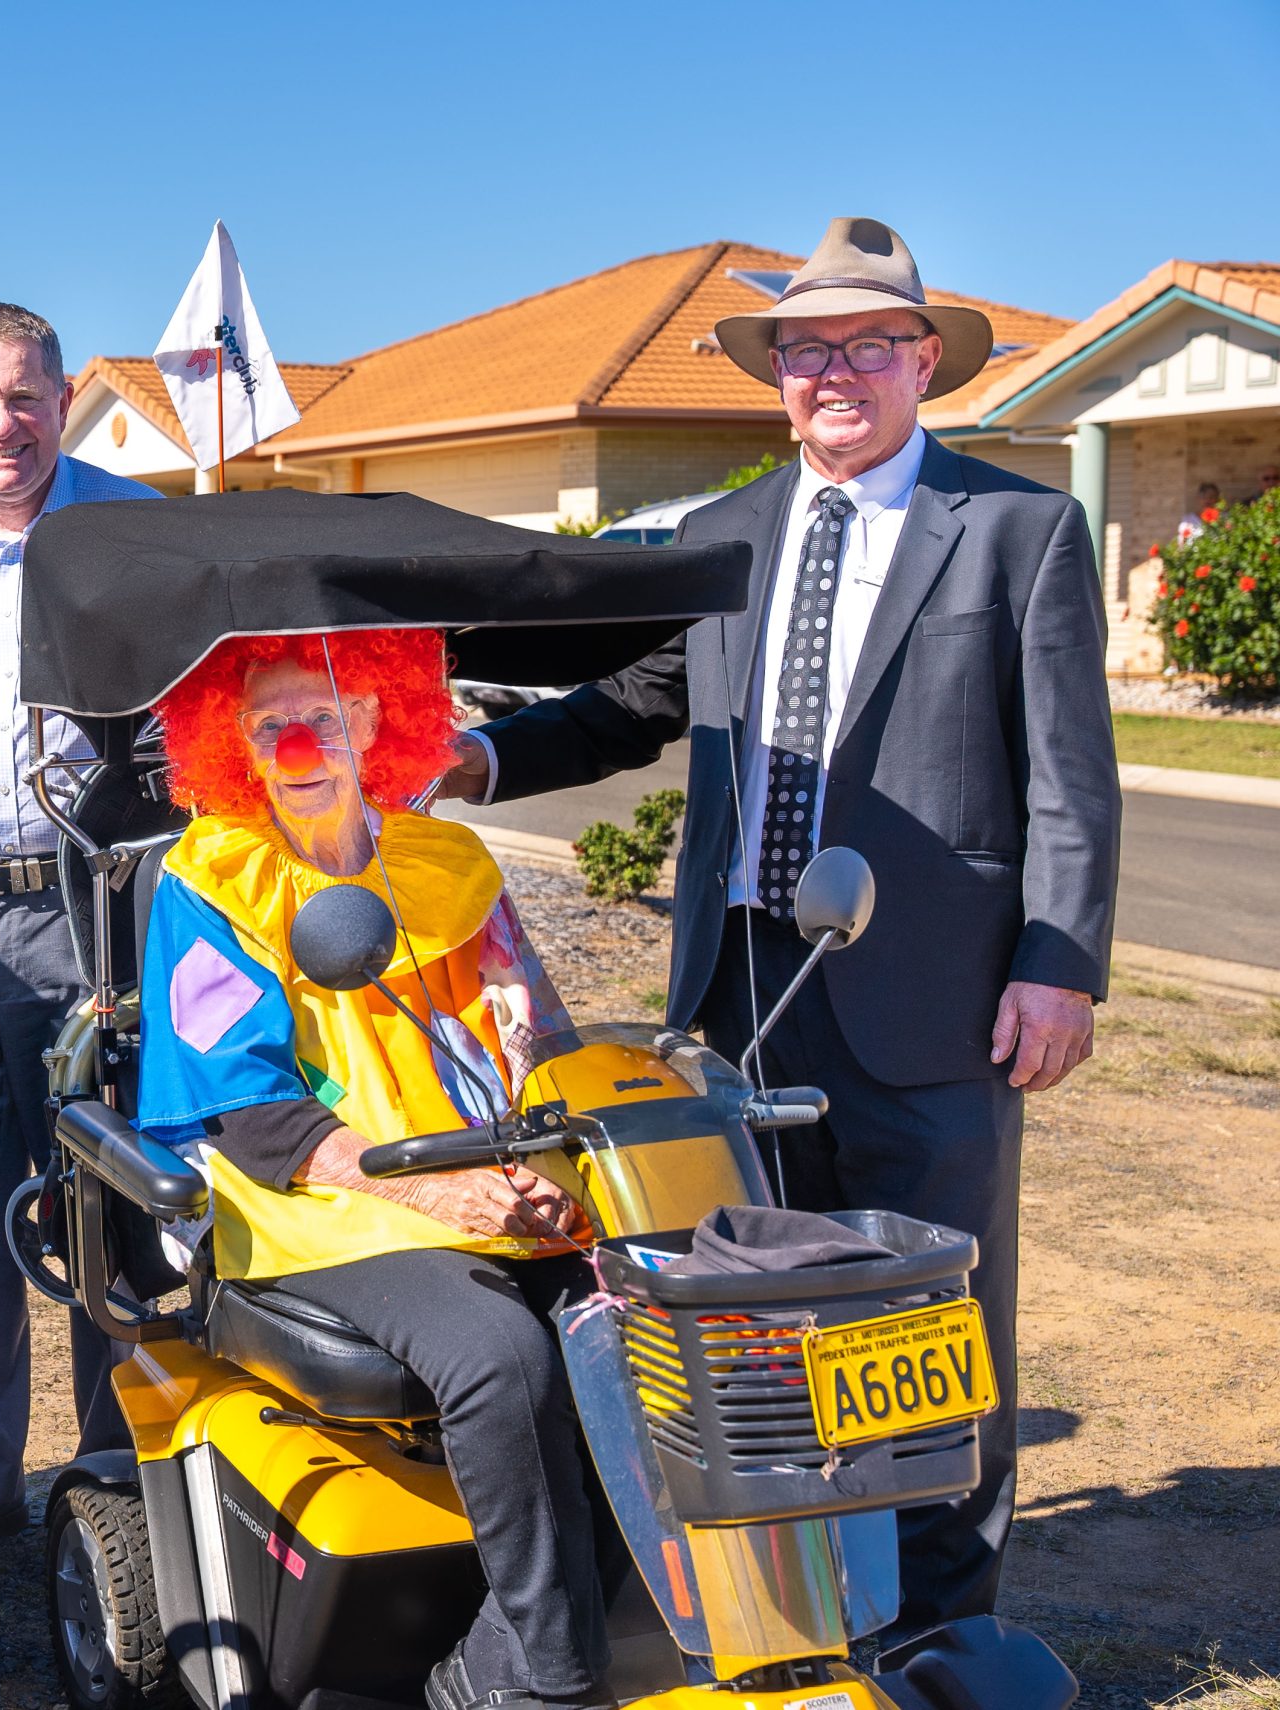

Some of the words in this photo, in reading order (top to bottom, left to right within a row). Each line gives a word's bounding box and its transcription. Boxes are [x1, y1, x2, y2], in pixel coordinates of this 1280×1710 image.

[818, 1344, 873, 1363] PEDESTRIAN
[875, 1335, 910, 1351] TRAFFIC
[912, 1328, 945, 1342] ROUTES
[947, 1322, 969, 1336] ONLY
[861, 1325, 899, 1340] MOTORISED
[902, 1315, 942, 1331] WHEELCHAIR
[834, 1339, 973, 1429] A686V
[222, 1493, 269, 1543] PATHRIDER
[806, 1694, 847, 1709] SCOOTERS
